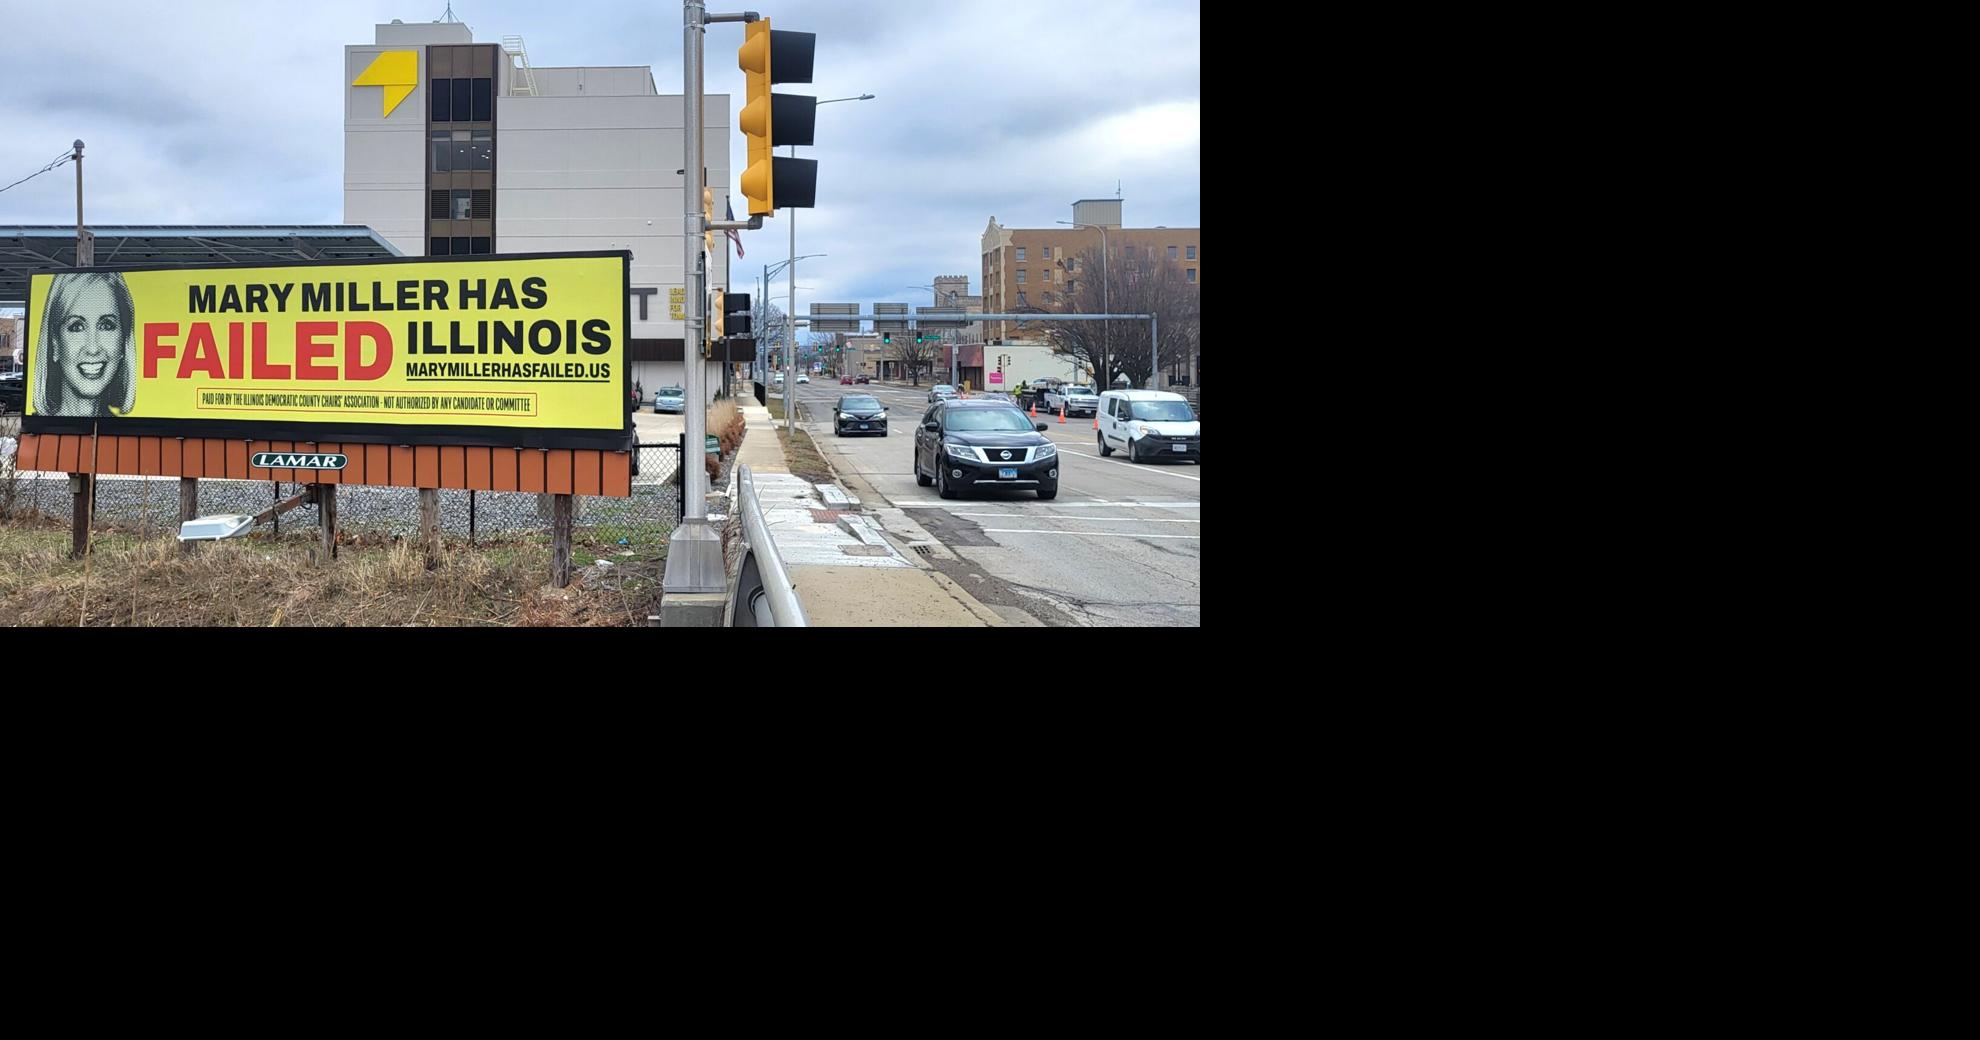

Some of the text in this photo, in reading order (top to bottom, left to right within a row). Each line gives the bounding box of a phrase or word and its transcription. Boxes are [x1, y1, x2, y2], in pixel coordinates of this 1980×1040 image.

[189, 277, 547, 314] MARY MILLER HAS
[143, 319, 612, 381] FAILED ILLINOIS
[406, 362, 611, 378] MARYMILLERHASFAILED.US
[202, 392, 214, 405] PAID
[215, 392, 225, 405] FOR
[225, 393, 233, 405] BY
[233, 393, 243, 406] THE
[243, 393, 264, 406] ILLINOIS
[265, 394, 298, 407] DEMOCRATIC
[299, 394, 320, 407] COUNTY
[343, 395, 380, 409] ASSOCIATION
[383, 396, 395, 409] NOT
[395, 396, 431, 410] AUTHORIZED
[431, 396, 439, 409] BY
[440, 396, 453, 410] ANY
[453, 397, 485, 411] CANDIDATE
[485, 398, 495, 411] OR
[495, 397, 531, 412] COMMITTEE
[259, 454, 337, 467] LAMAR
